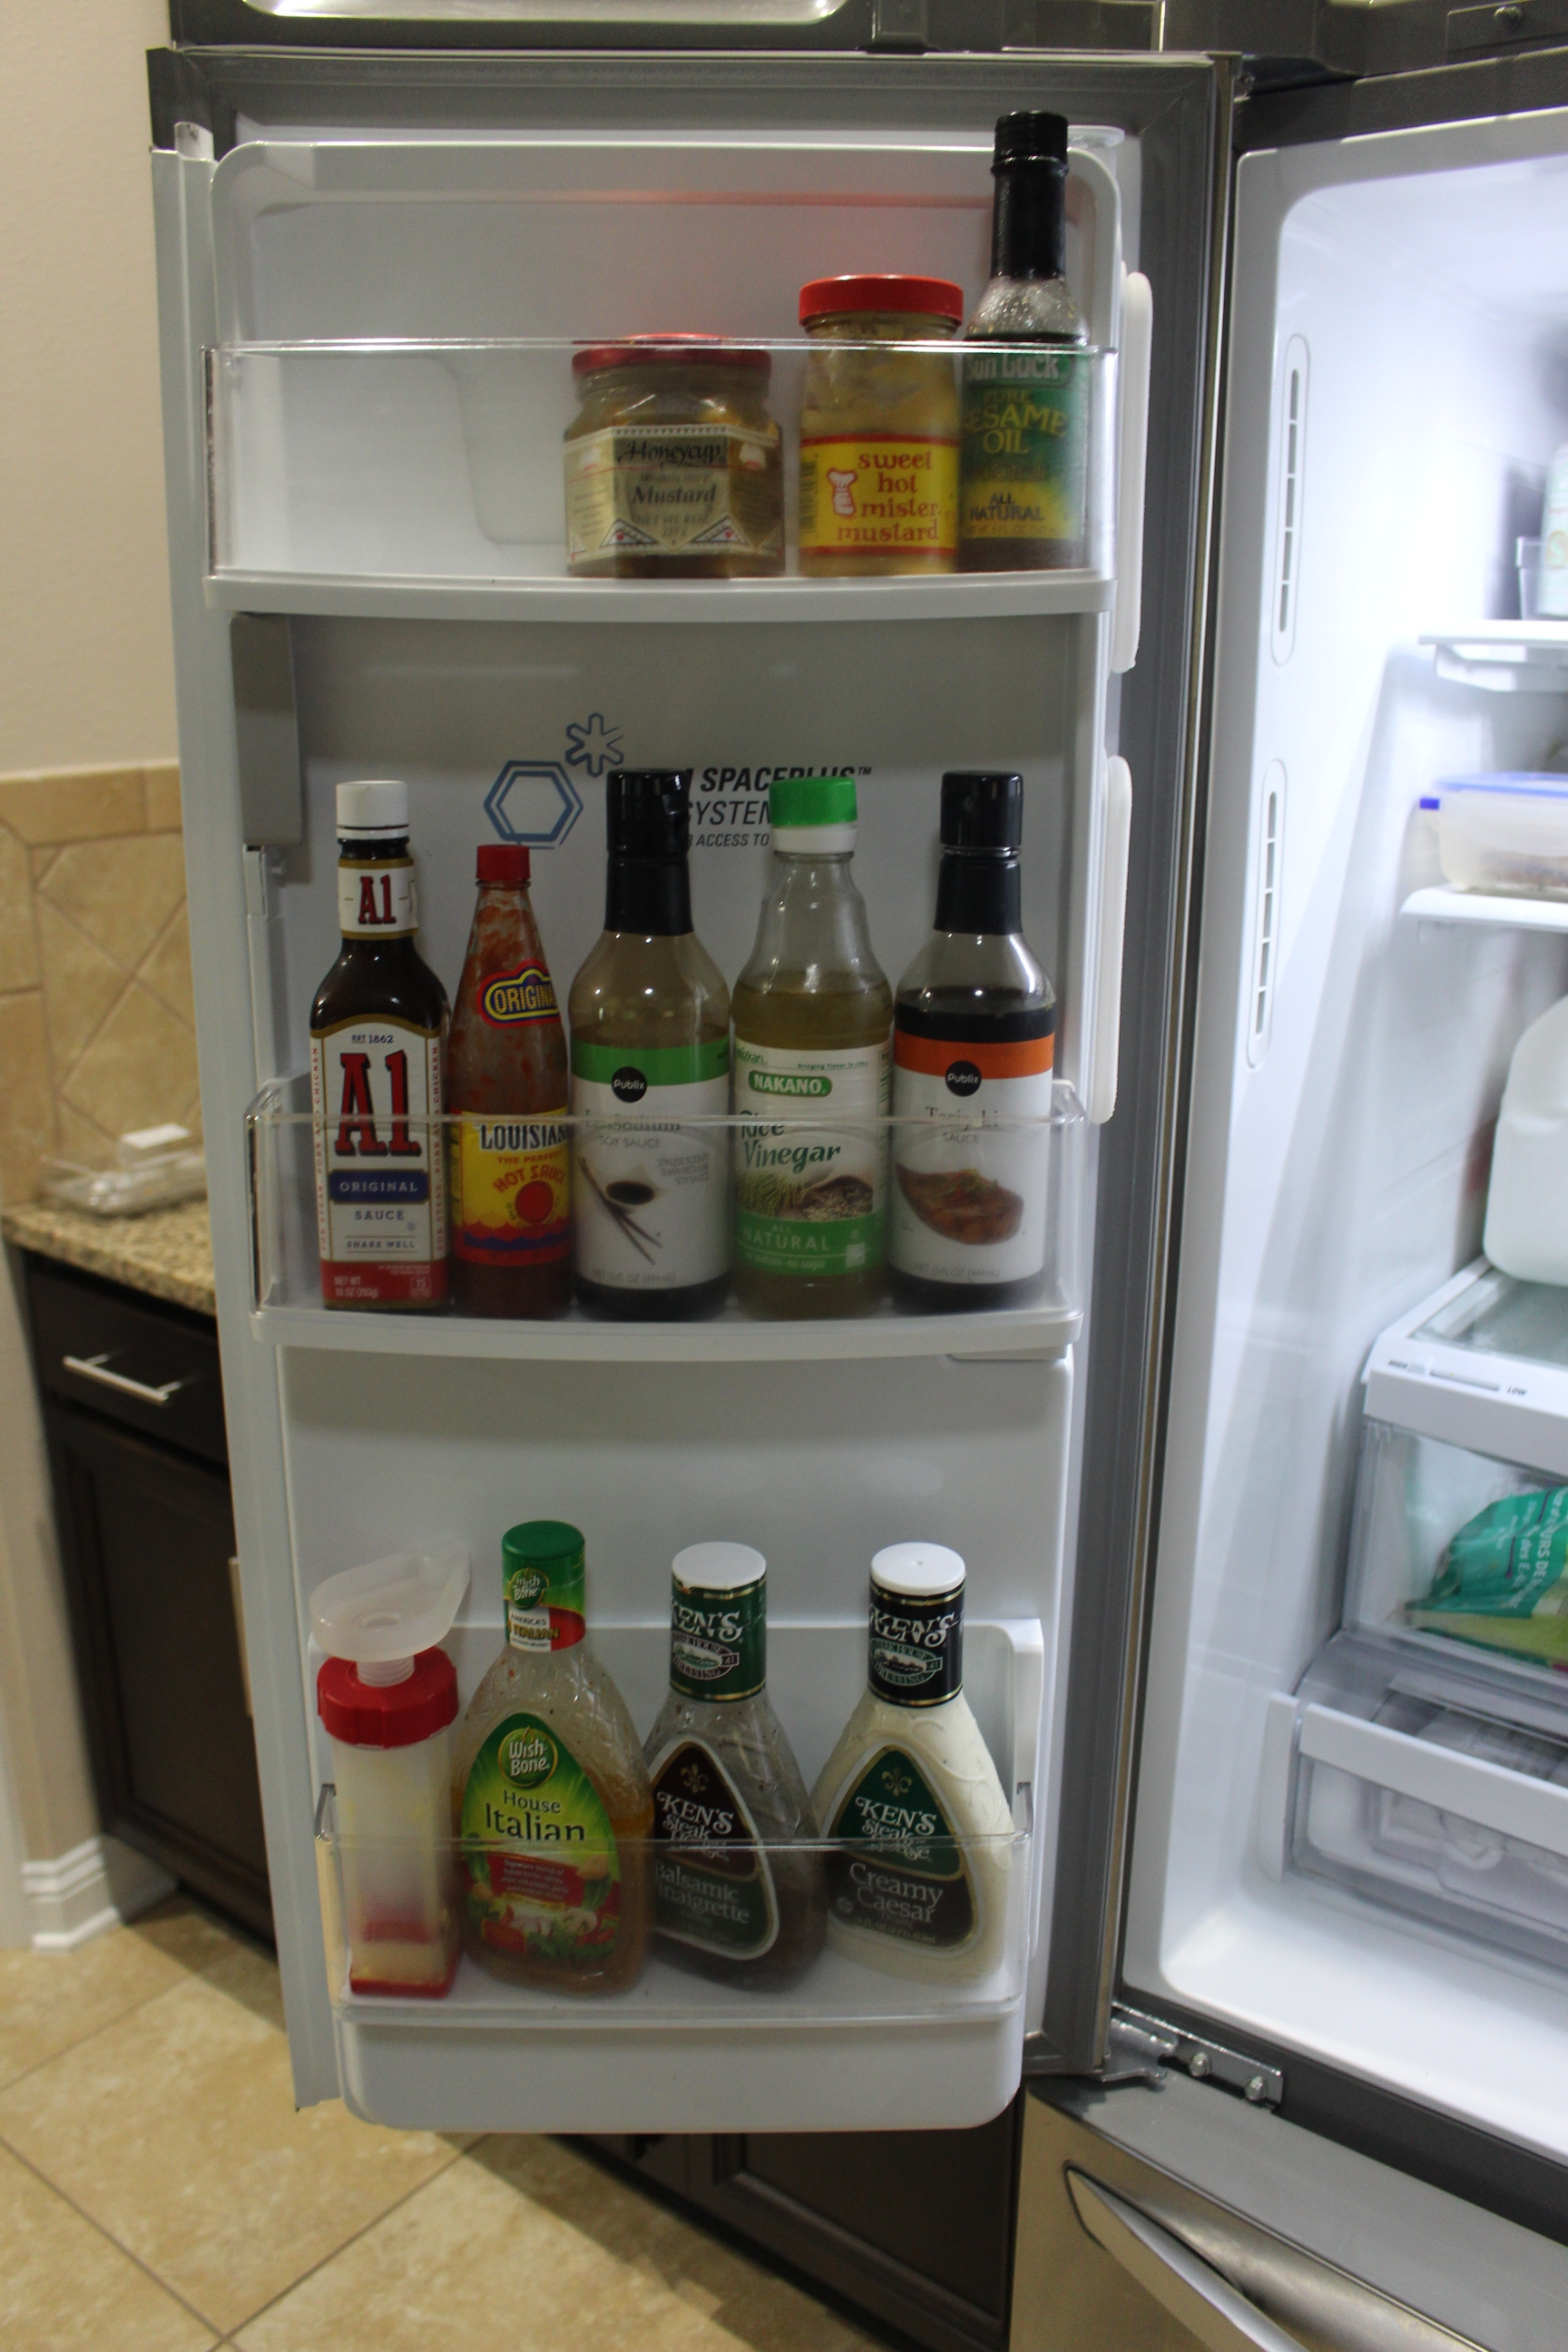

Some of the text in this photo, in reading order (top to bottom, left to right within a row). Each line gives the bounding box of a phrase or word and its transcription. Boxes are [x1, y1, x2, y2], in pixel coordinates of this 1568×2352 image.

[1002, 349, 1060, 379] Luck
[965, 404, 1069, 438] ESAME
[983, 429, 1030, 454] OIL
[618, 440, 721, 468] Honeycup
[858, 450, 932, 470] sweet
[877, 472, 917, 493] hot
[632, 484, 716, 504] Mustard
[990, 492, 1015, 505] ALL
[860, 496, 939, 518] mister
[970, 505, 1045, 521] NATURAL
[836, 518, 939, 542] mustard
[695, 833, 749, 847] ACCESS
[753, 833, 769, 846] TO
[368, 1034, 394, 1044] 1862
[613, 1078, 645, 1091] Publix
[754, 1074, 822, 1093] NAKANO
[947, 1073, 980, 1084] Publix
[623, 1137, 662, 1149] SAUCE
[497, 1156, 519, 1164] THE
[742, 1140, 841, 1174] Vinegar
[339, 1181, 417, 1192] ORIGINAL
[492, 1168, 524, 1193] HOT
[354, 1210, 405, 1220] SAUCE
[346, 1240, 415, 1249] SHAKE WELL
[743, 1226, 830, 1251] NATURAL
[1506, 1387, 1528, 1397] LOW
[514, 1587, 539, 1601] Bone
[871, 1604, 956, 1648] KEN'S
[510, 1757, 550, 1777] Bone
[504, 1789, 561, 1814] House
[657, 1791, 734, 1834] KEN'S
[485, 1803, 585, 1841] Italian
[662, 1814, 711, 1839] Steak
[855, 1797, 937, 1836] KEN'S
[861, 1818, 914, 1840] Steak
[655, 1860, 739, 1903] Balsamic
[849, 1862, 944, 1909] Creamy
[656, 1881, 750, 1925] inaigrette
[857, 1886, 936, 1923] Caesar
